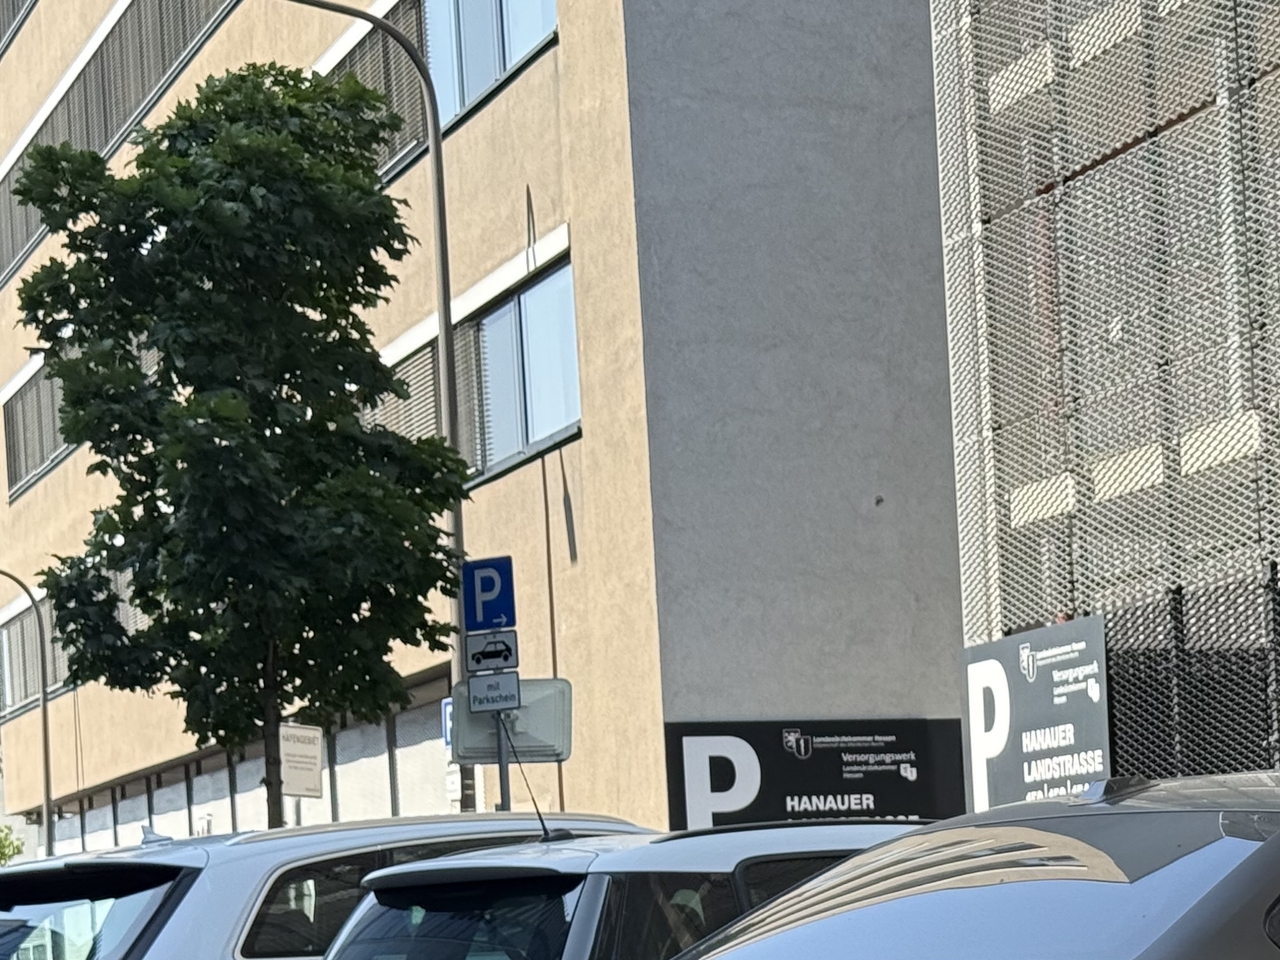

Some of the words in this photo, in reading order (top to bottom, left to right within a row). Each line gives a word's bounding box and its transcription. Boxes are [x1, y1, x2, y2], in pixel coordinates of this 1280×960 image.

[474, 567, 501, 623] P
[473, 692, 516, 705] Parkschein
[487, 681, 500, 691] mit
[966, 658, 1010, 813] P
[1022, 723, 1075, 753] HANAUER
[841, 750, 916, 763] Versorgungswerk
[1023, 749, 1104, 783] LANDSTRASSE
[682, 735, 762, 831] P
[786, 793, 875, 812] HANAUER
